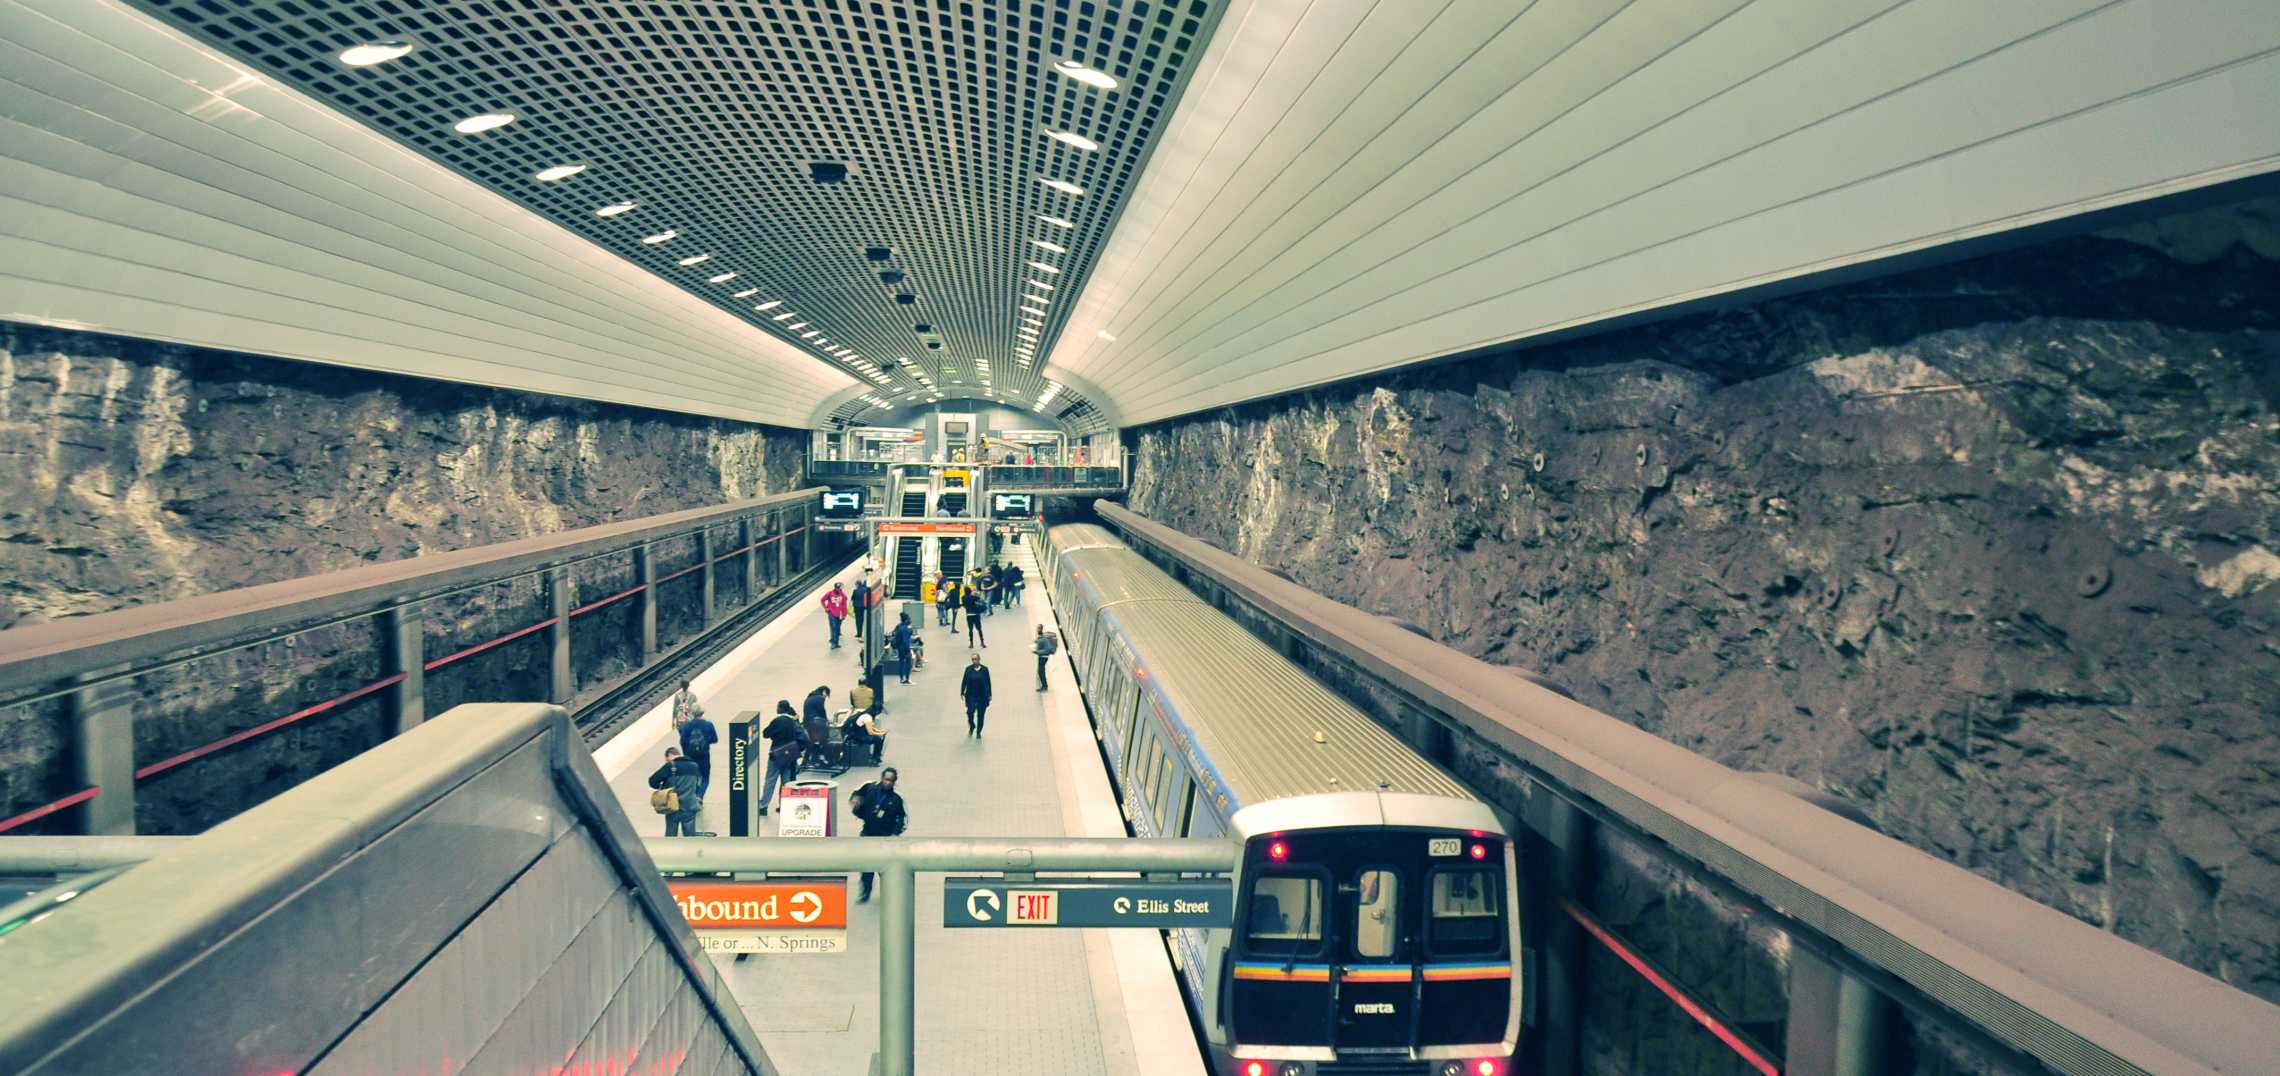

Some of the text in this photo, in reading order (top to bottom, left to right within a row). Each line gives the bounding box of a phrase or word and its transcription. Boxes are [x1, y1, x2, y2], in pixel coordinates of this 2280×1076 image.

[732, 738, 747, 791] Directory
[781, 828, 823, 837] UPGRADE
[1433, 841, 1458, 854] 270
[1017, 894, 1050, 920] EXIT
[1136, 899, 1209, 914] Ellis Street
[723, 939, 738, 950] or
[757, 936, 774, 950] N.
[779, 935, 836, 953] Springs
